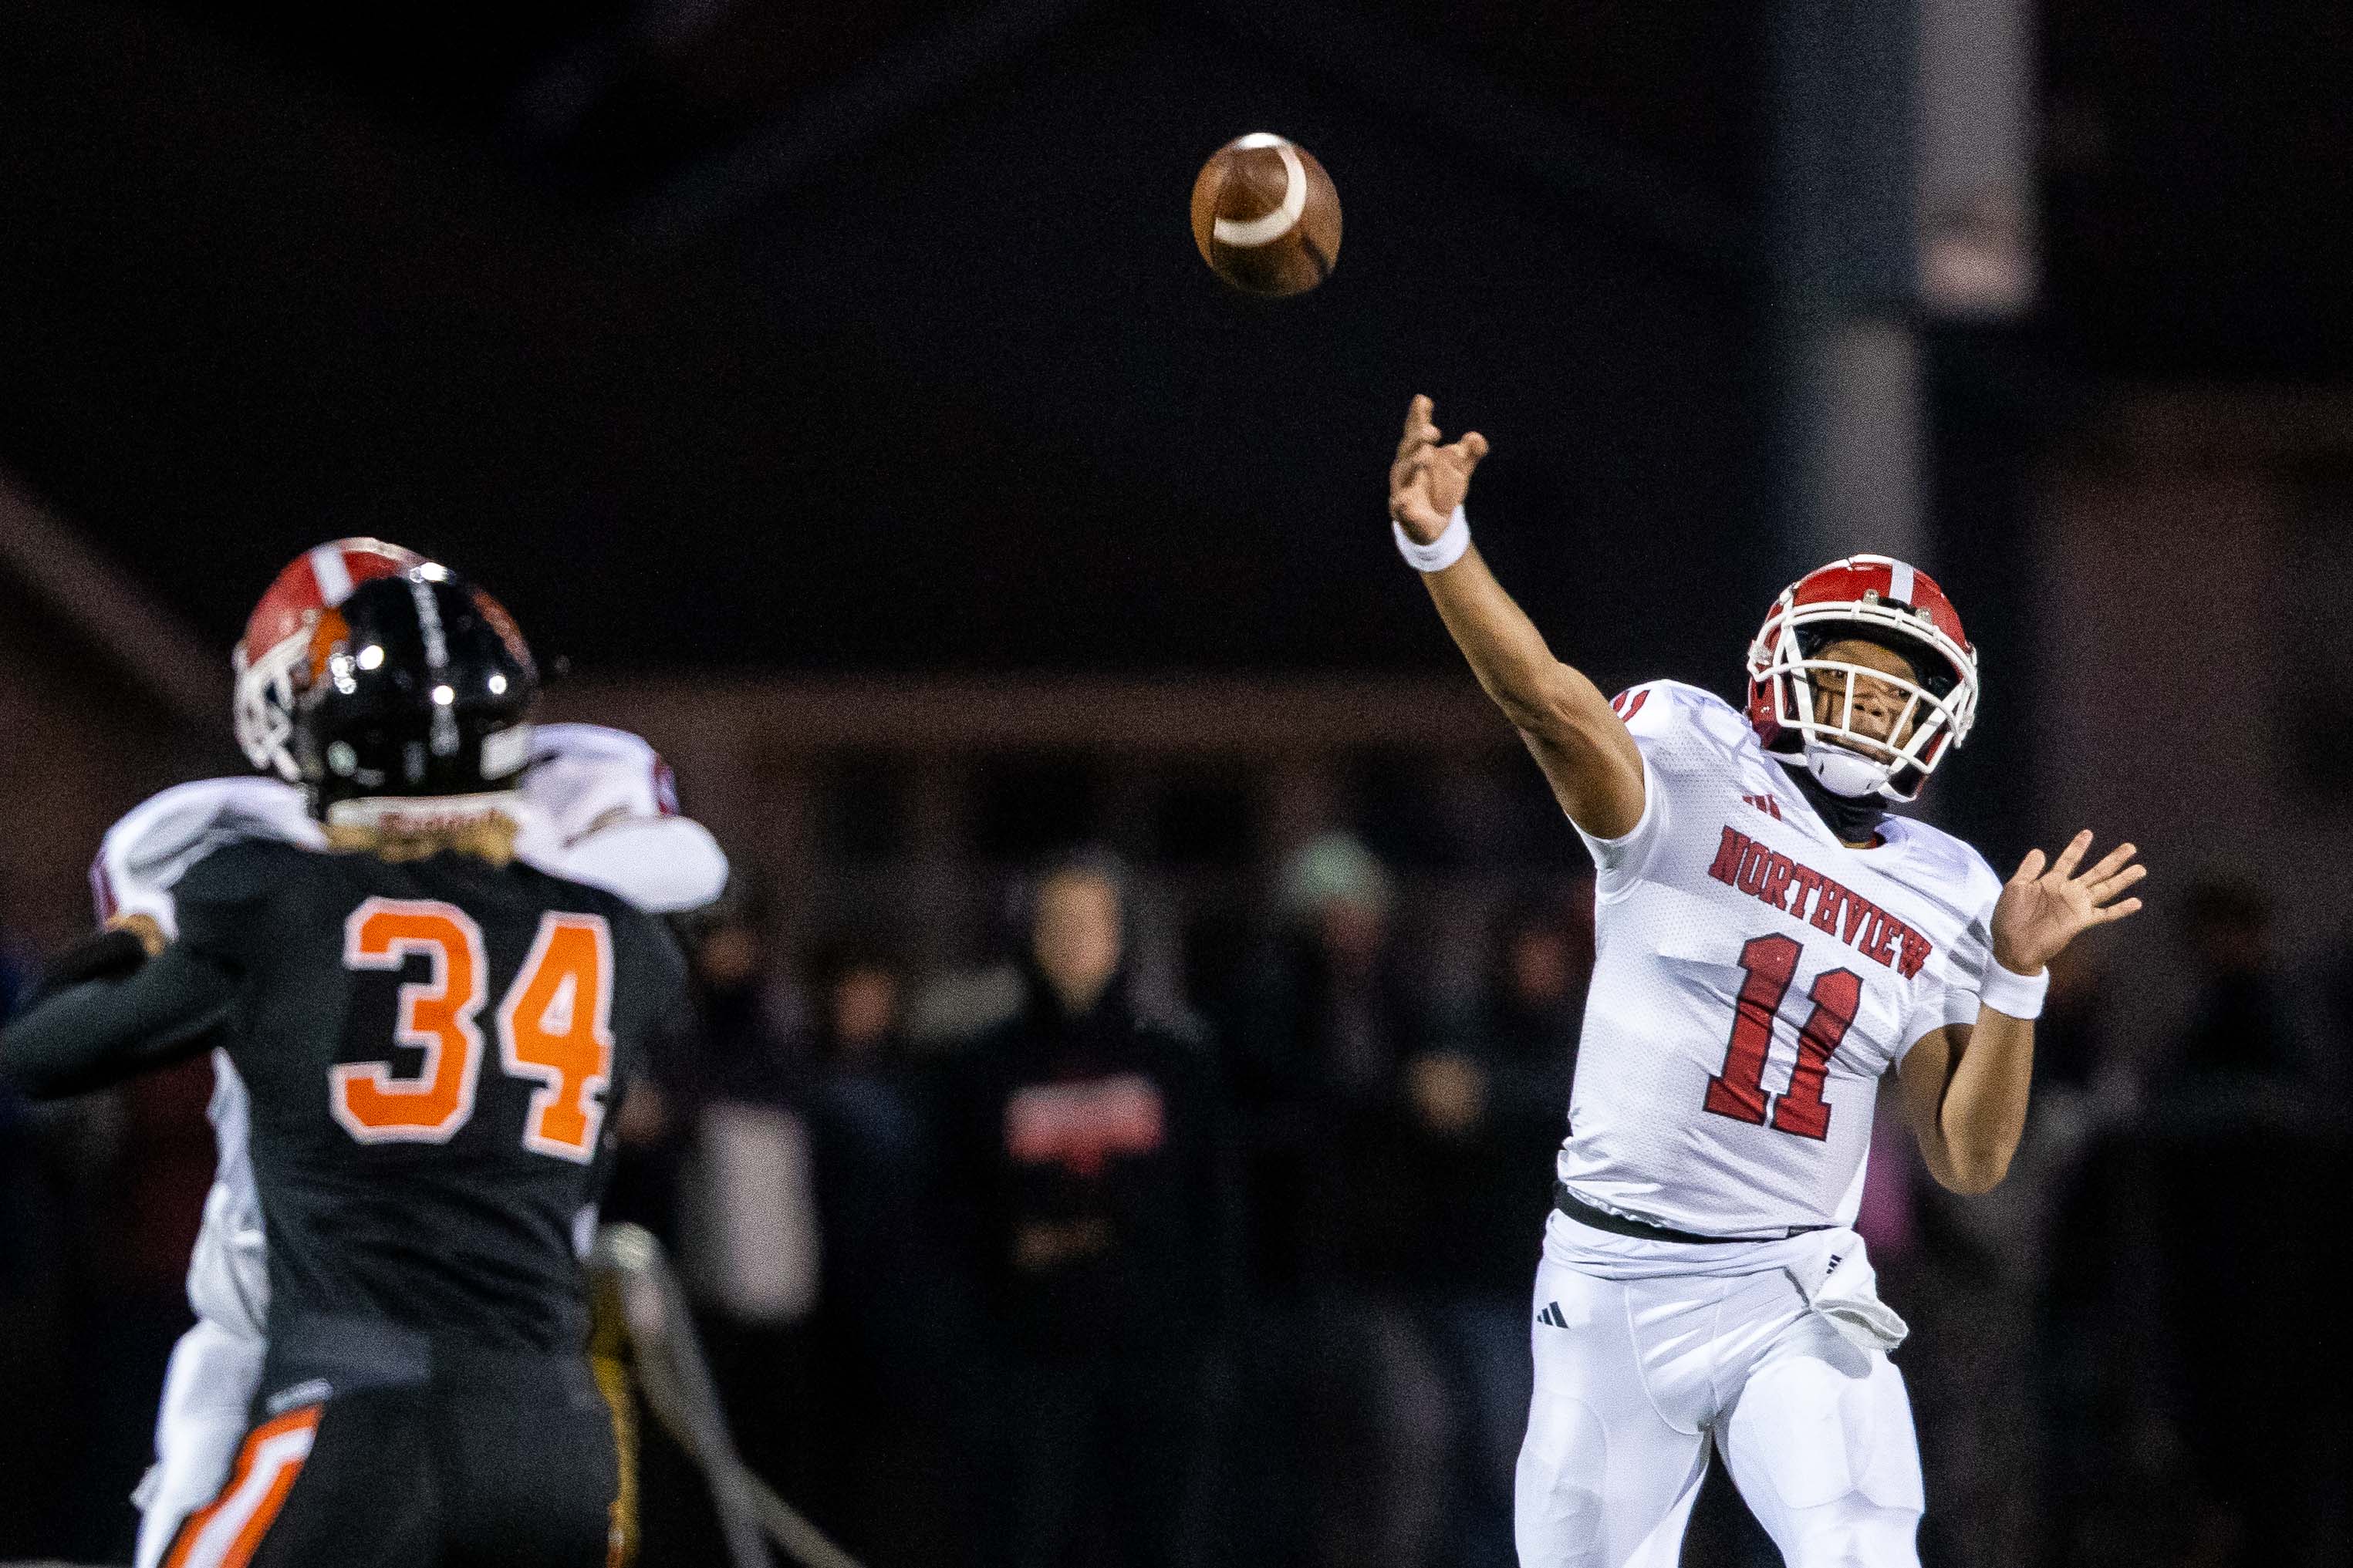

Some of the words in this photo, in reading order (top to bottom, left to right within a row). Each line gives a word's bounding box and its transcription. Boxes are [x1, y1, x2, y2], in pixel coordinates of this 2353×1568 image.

[1708, 824, 1933, 980] NORTHVIEW
[328, 896, 615, 1165] 34
[1704, 932, 1864, 1141] 11
